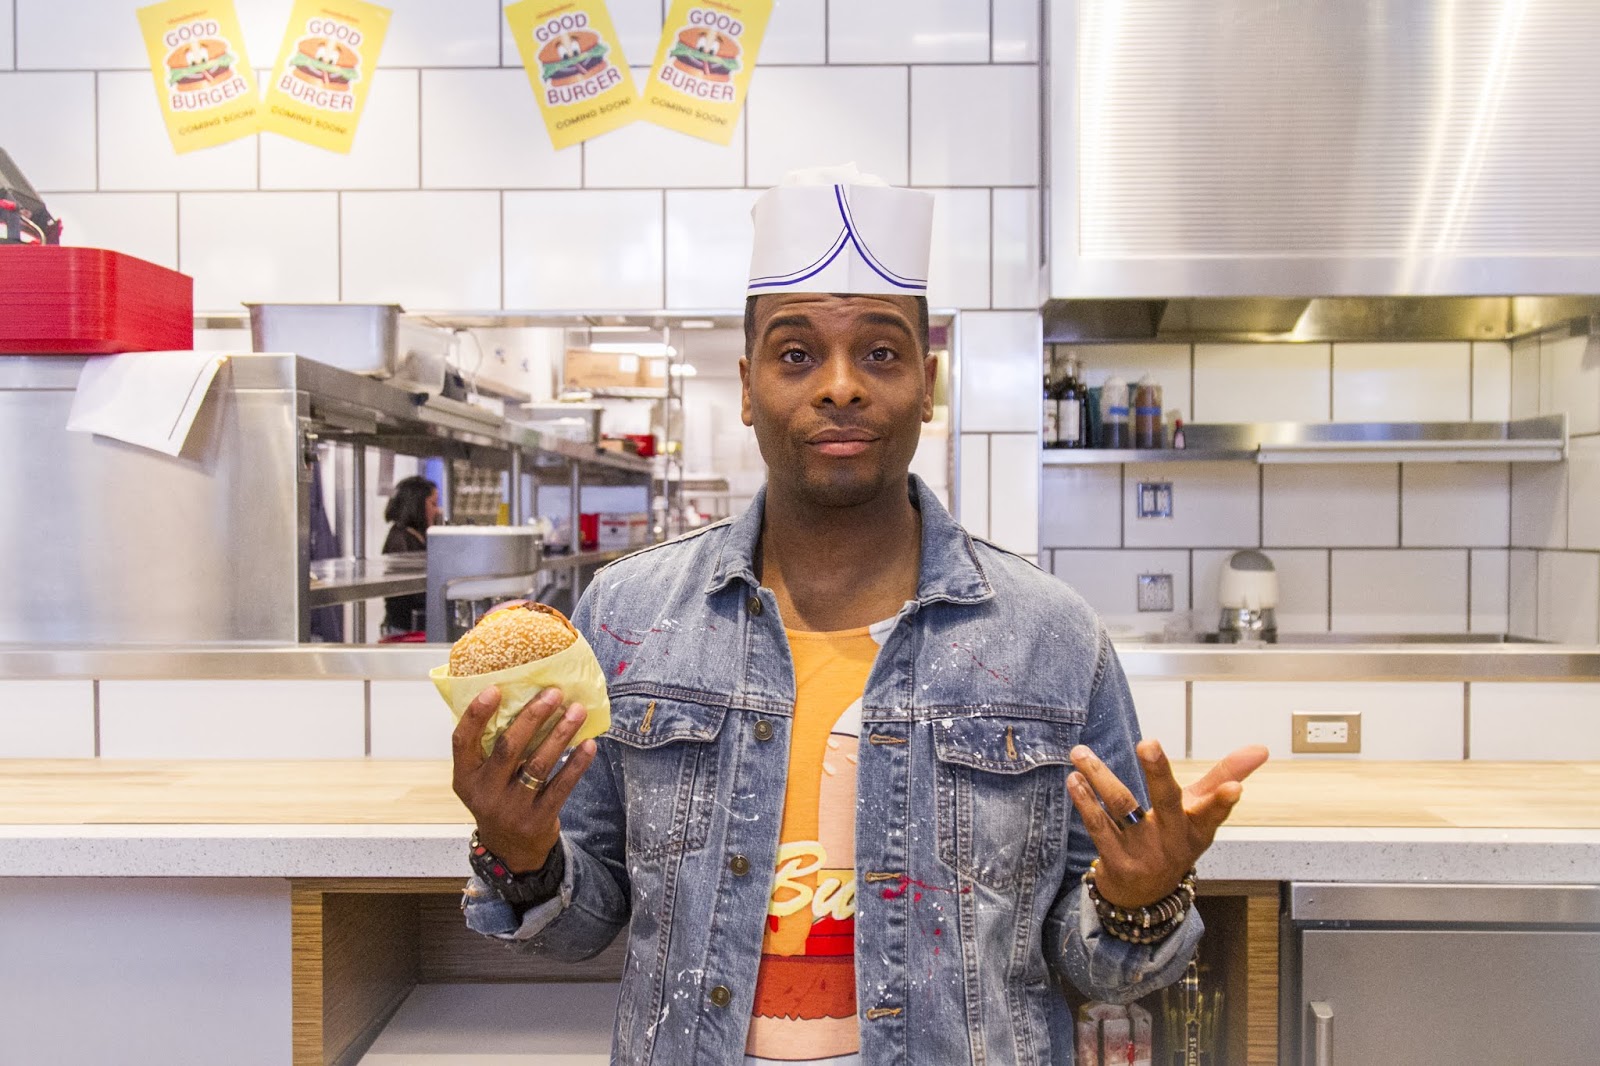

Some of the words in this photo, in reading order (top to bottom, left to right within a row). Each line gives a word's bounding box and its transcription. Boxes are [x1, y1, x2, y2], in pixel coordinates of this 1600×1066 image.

[166, 21, 218, 47] GOOD
[309, 20, 361, 46] GOOD
[535, 13, 587, 43] GOOD
[690, 10, 742, 37] GOOD
[172, 78, 248, 109] BURGER
[280, 75, 353, 110] BURGER
[547, 68, 621, 104] BURGER
[660, 66, 734, 100] BURGER
[271, 105, 312, 125] COMING
[651, 96, 693, 115] COMING
[178, 117, 221, 136] COMING
[556, 109, 598, 130] COMING
